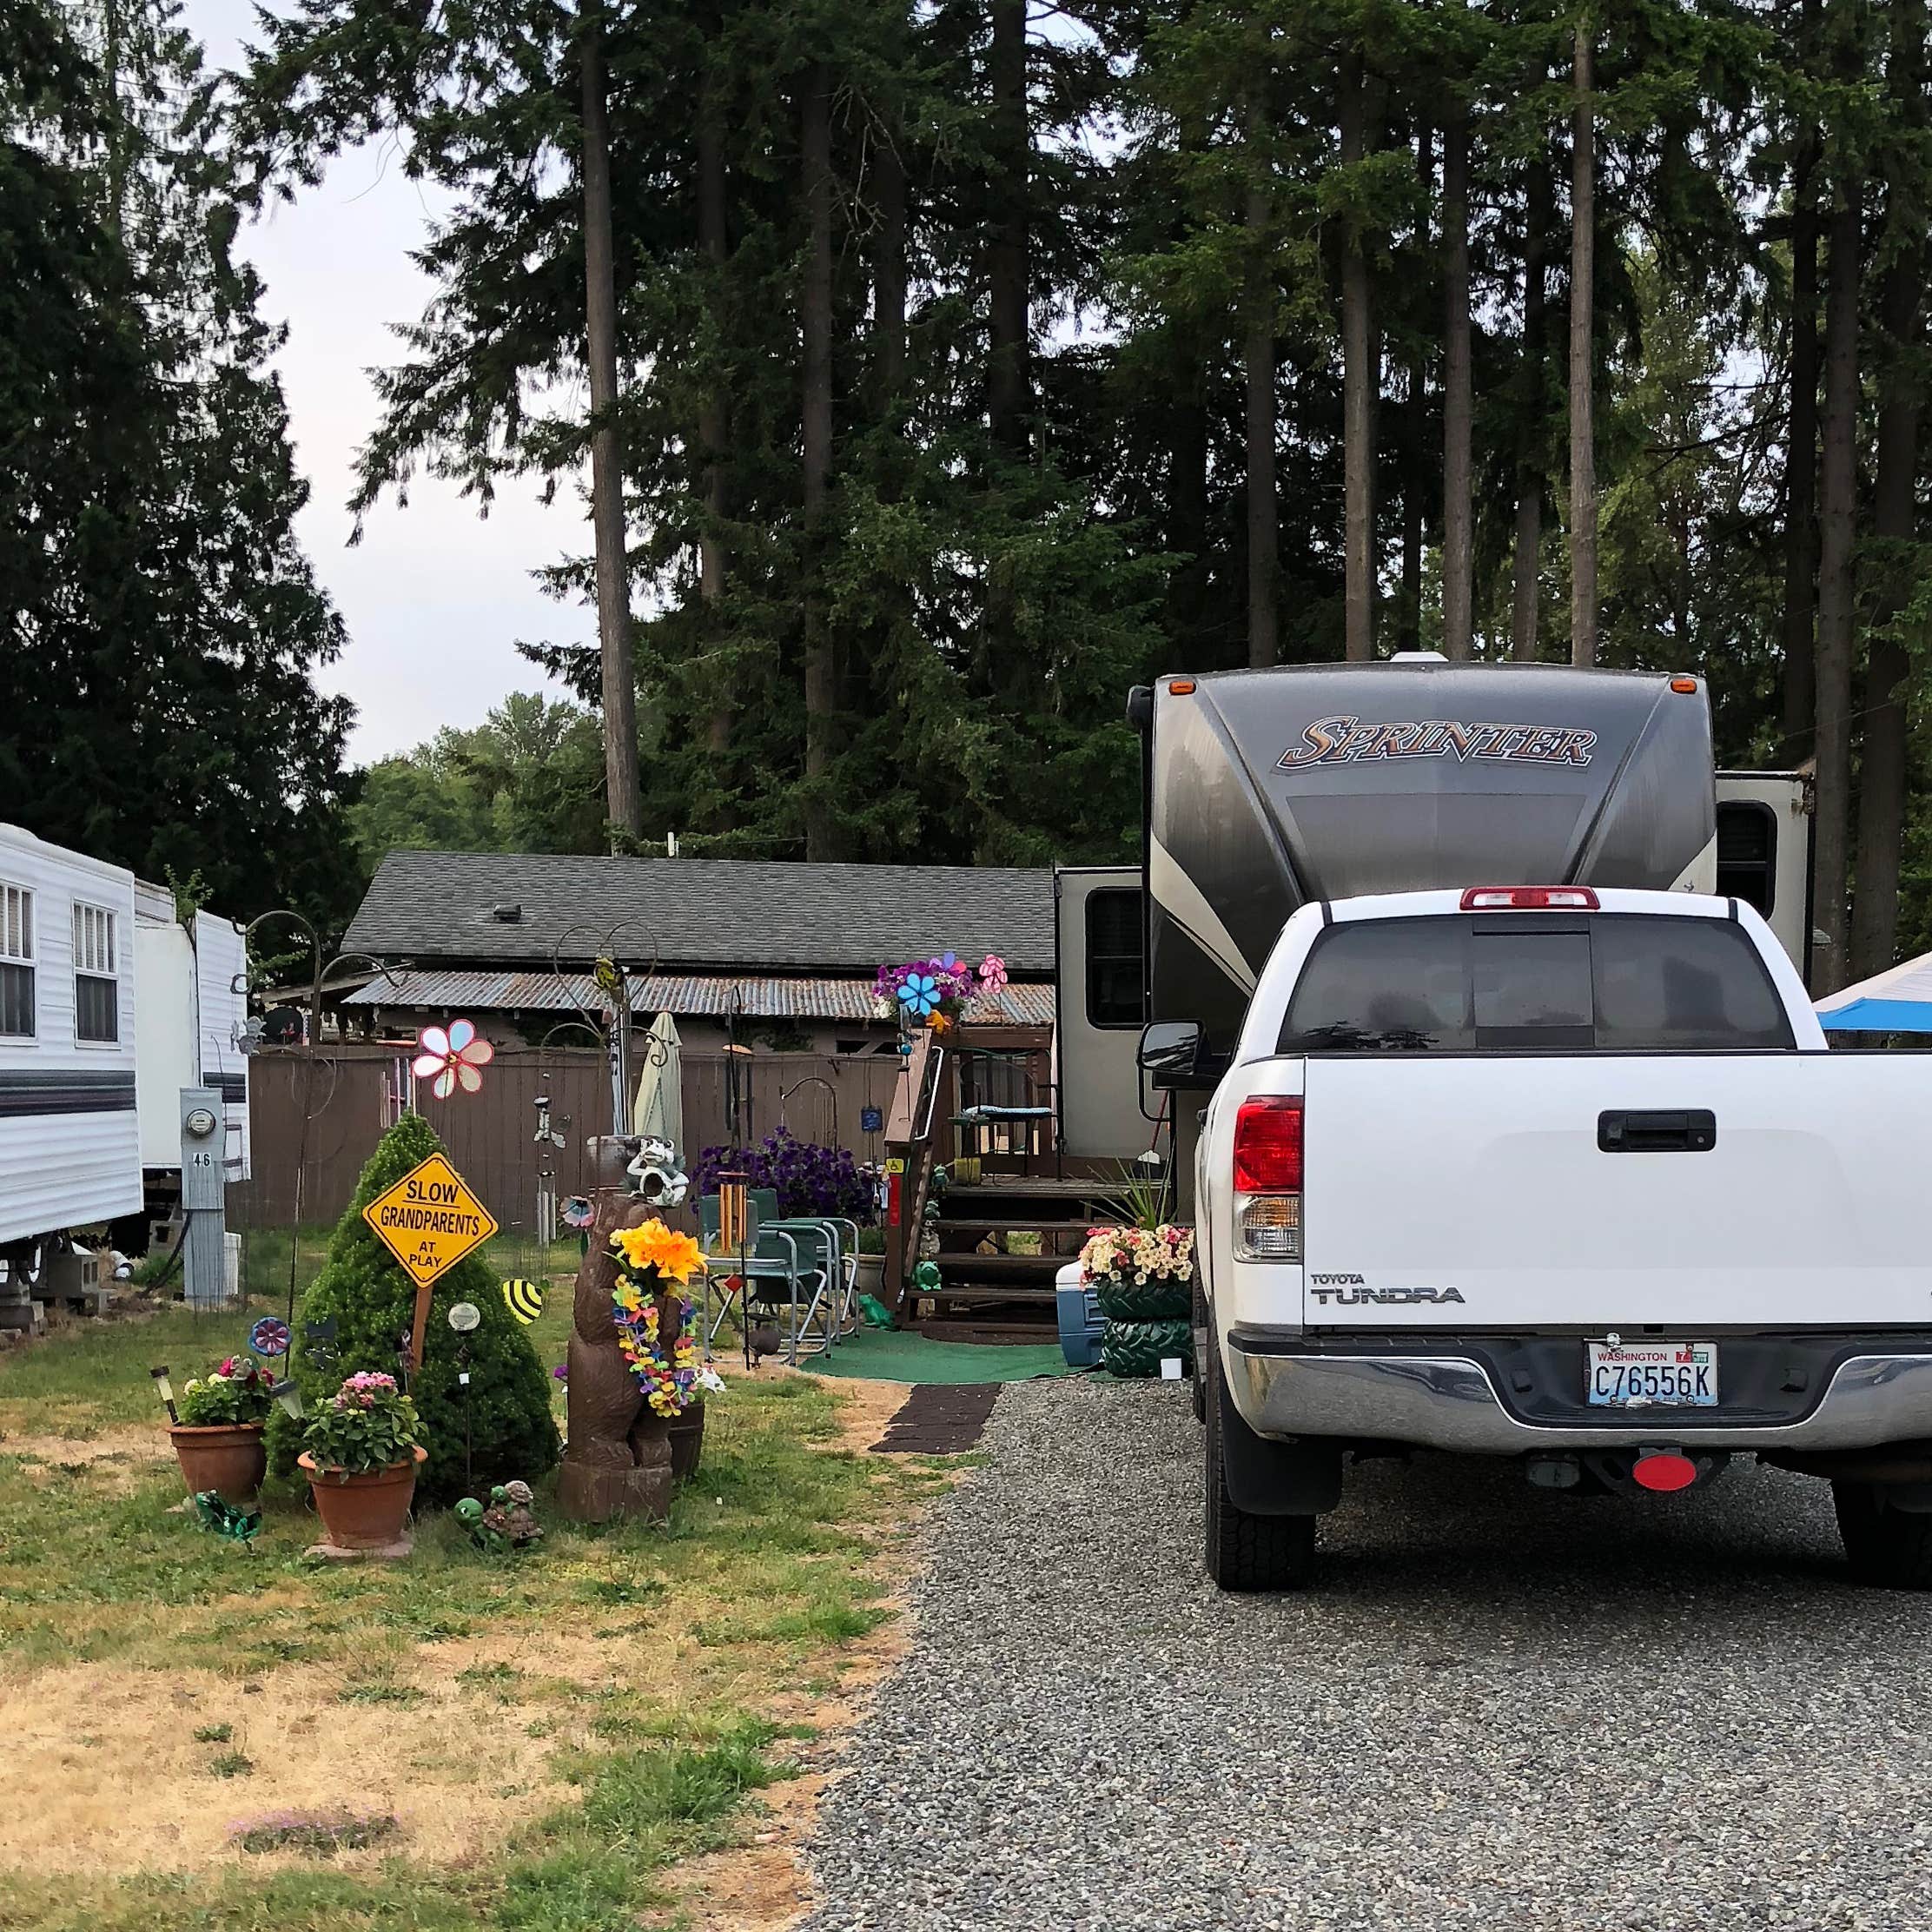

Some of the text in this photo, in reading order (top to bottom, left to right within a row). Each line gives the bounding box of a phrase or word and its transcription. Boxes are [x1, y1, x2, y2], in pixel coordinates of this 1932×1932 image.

[1276, 715, 1598, 767] SPRINTER
[194, 1154, 210, 1166] 46
[406, 1180, 459, 1203] SLOW
[380, 1206, 480, 1237] GRANDPARENTS
[419, 1241, 436, 1253] AT
[409, 1254, 443, 1267] PLAY
[1310, 1274, 1365, 1284] TOYOTA
[1310, 1287, 1466, 1304] TUNDRA
[1598, 1353, 1668, 1362] WASHINGTON
[1596, 1366, 1710, 1397] C76556K
